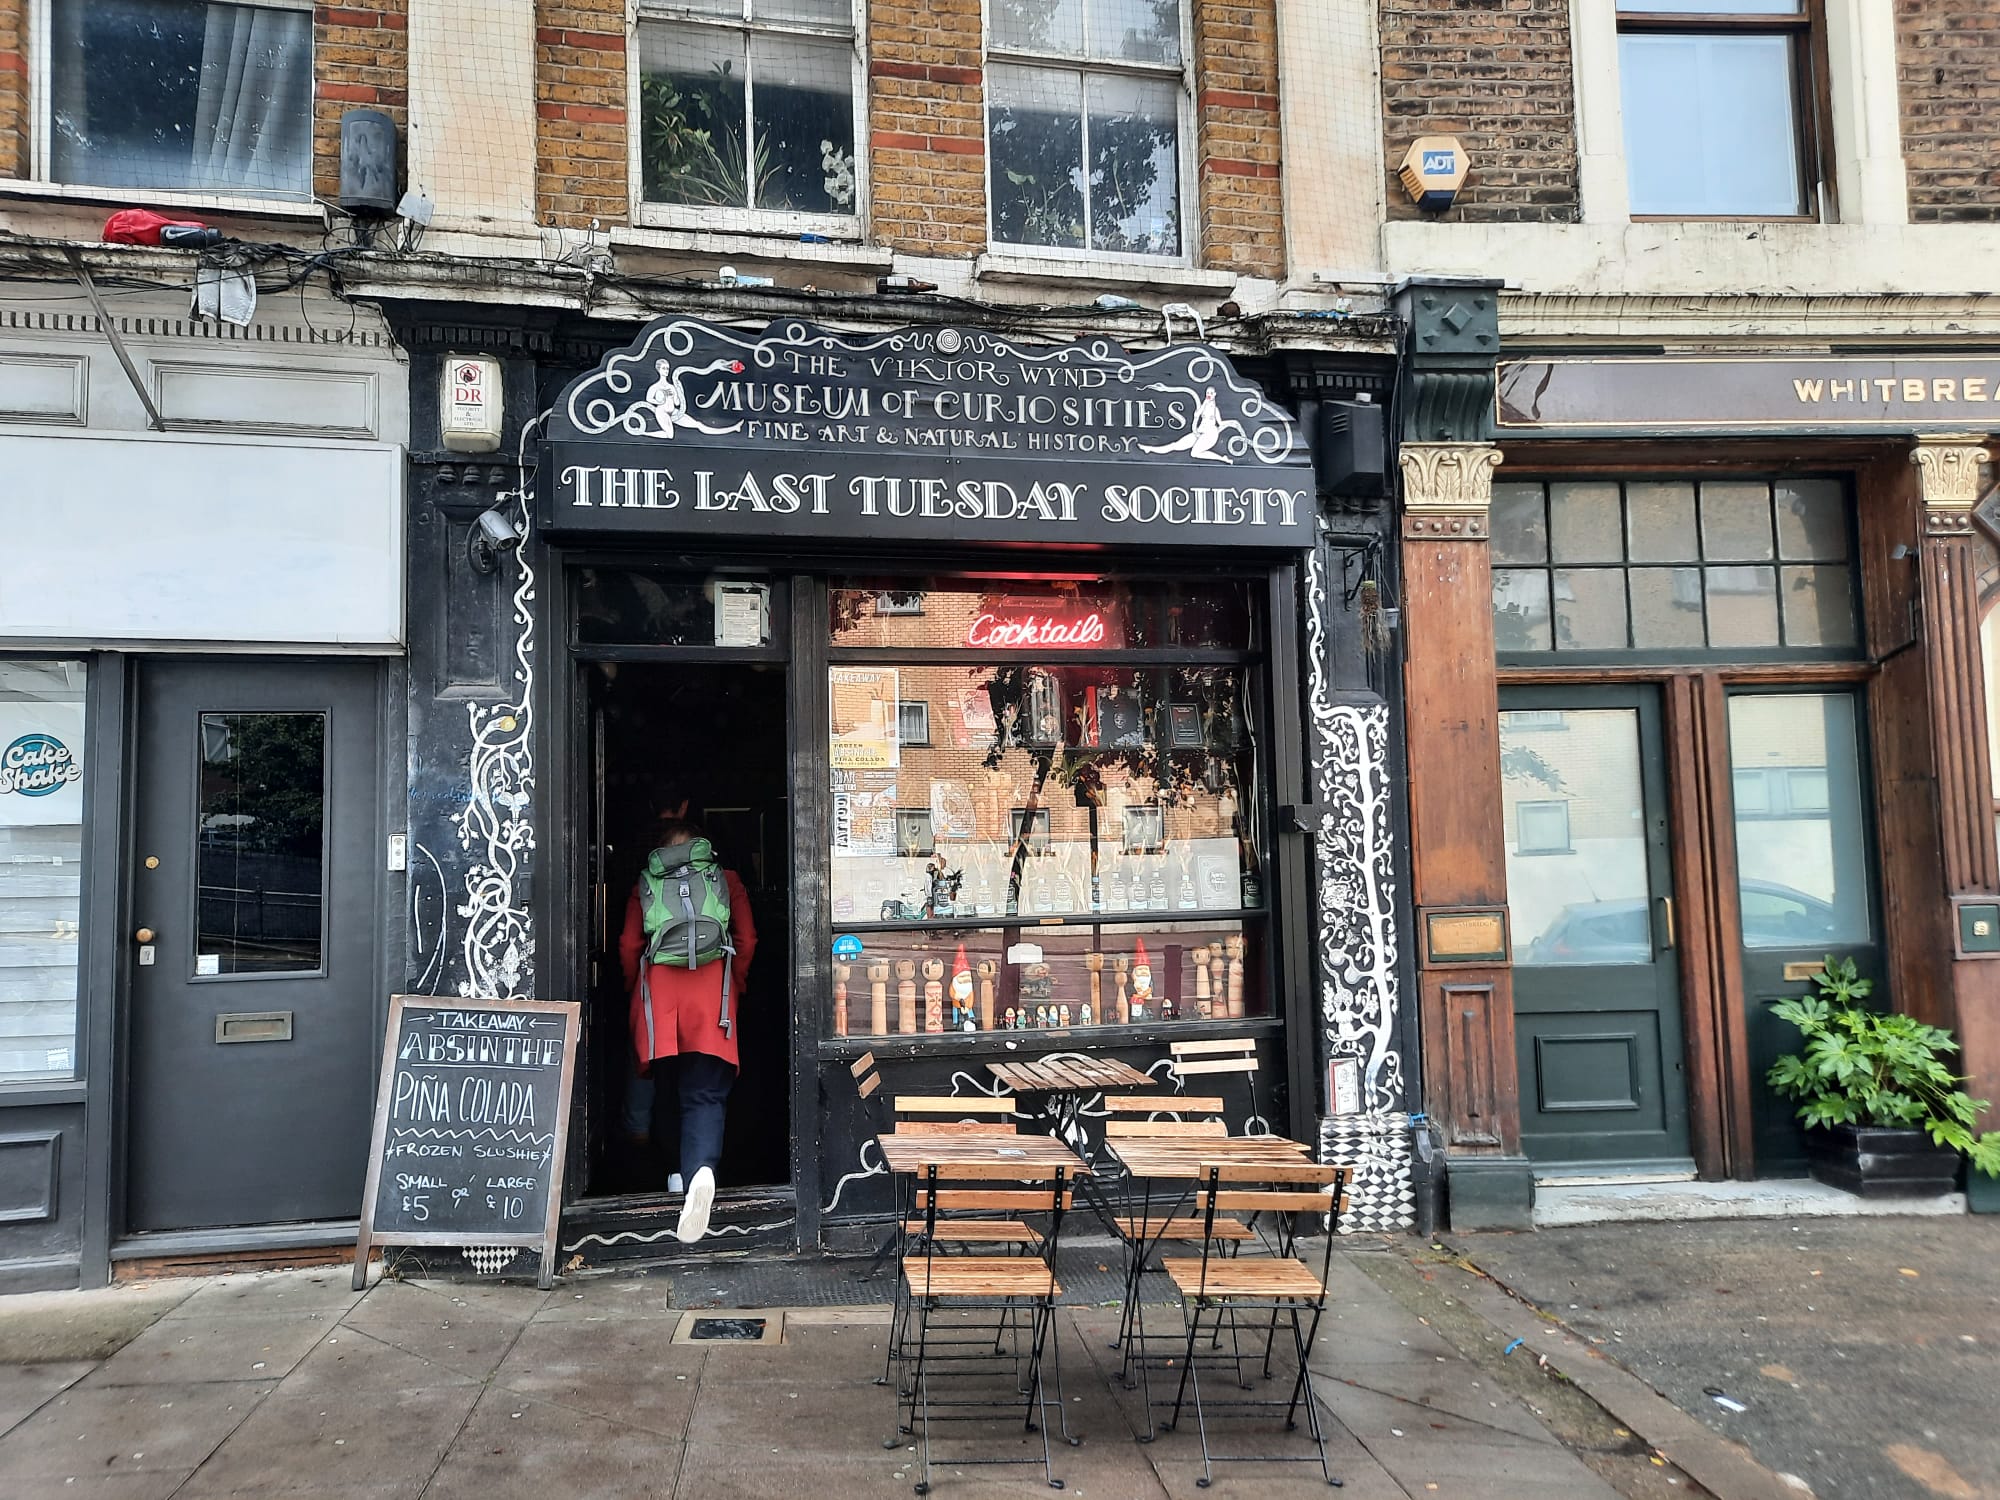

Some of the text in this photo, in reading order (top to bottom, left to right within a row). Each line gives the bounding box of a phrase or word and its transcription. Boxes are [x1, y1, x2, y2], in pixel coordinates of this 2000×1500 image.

[1424, 155, 1455, 170] ADT
[783, 351, 1107, 389] THE VIKTOR WYND
[455, 387, 482, 402] DR
[1792, 378, 2000, 402] WHITBRE
[695, 381, 1187, 430] MUSEUM OF CURIOSITIES
[747, 420, 1140, 454] FINE ART & NATURAL HISTORY
[560, 465, 1308, 526] THE LAST TUESDAY SOCIETY
[968, 613, 1104, 645] Cocktails
[6, 743, 72, 769] Cake
[0, 763, 82, 794] Shake
[436, 1012, 527, 1031] TAKEAWAY
[399, 1033, 563, 1066] ABSINTHE
[393, 1072, 536, 1127] PIÑA COLADA
[395, 1142, 463, 1158] FROZEN
[396, 1173, 448, 1190] SMALL
[486, 1177, 536, 1190] LARGE
[402, 1196, 430, 1221] £5
